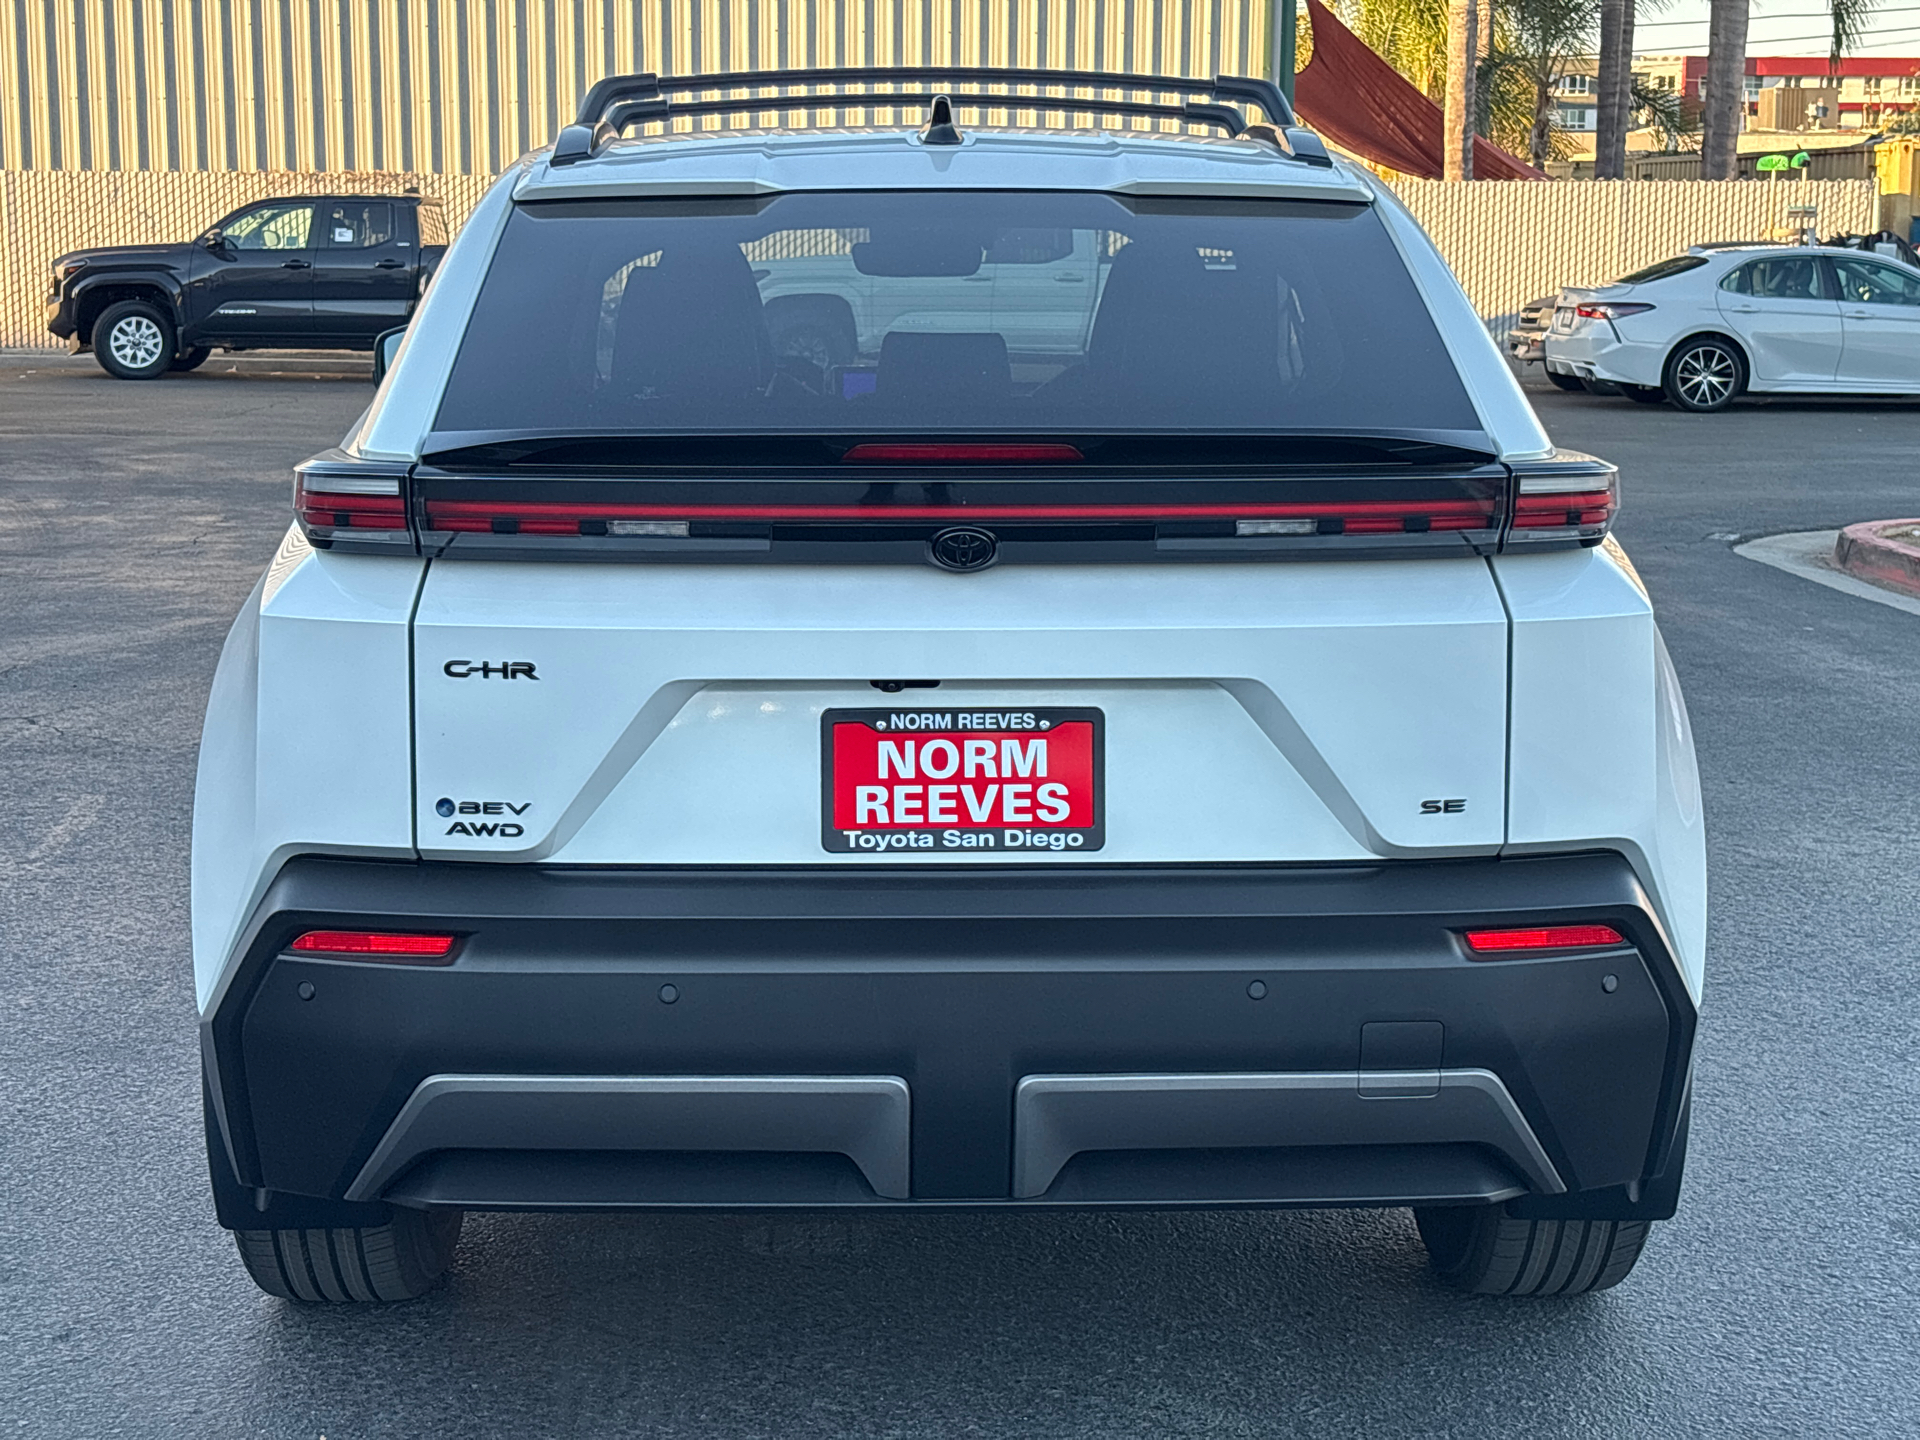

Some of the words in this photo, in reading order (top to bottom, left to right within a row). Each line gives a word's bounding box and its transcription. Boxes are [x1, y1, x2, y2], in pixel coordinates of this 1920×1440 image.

[443, 660, 540, 681] C-HR
[890, 713, 952, 730] NORM
[958, 712, 1036, 730] REEVES
[877, 739, 1048, 779] NORM
[458, 801, 532, 816] BEV
[855, 782, 1071, 824] REEVES
[1419, 798, 1467, 814] SE
[445, 821, 524, 837] AWD
[842, 830, 934, 851] Toyota
[942, 830, 995, 848] San
[1004, 829, 1084, 850] Diego
